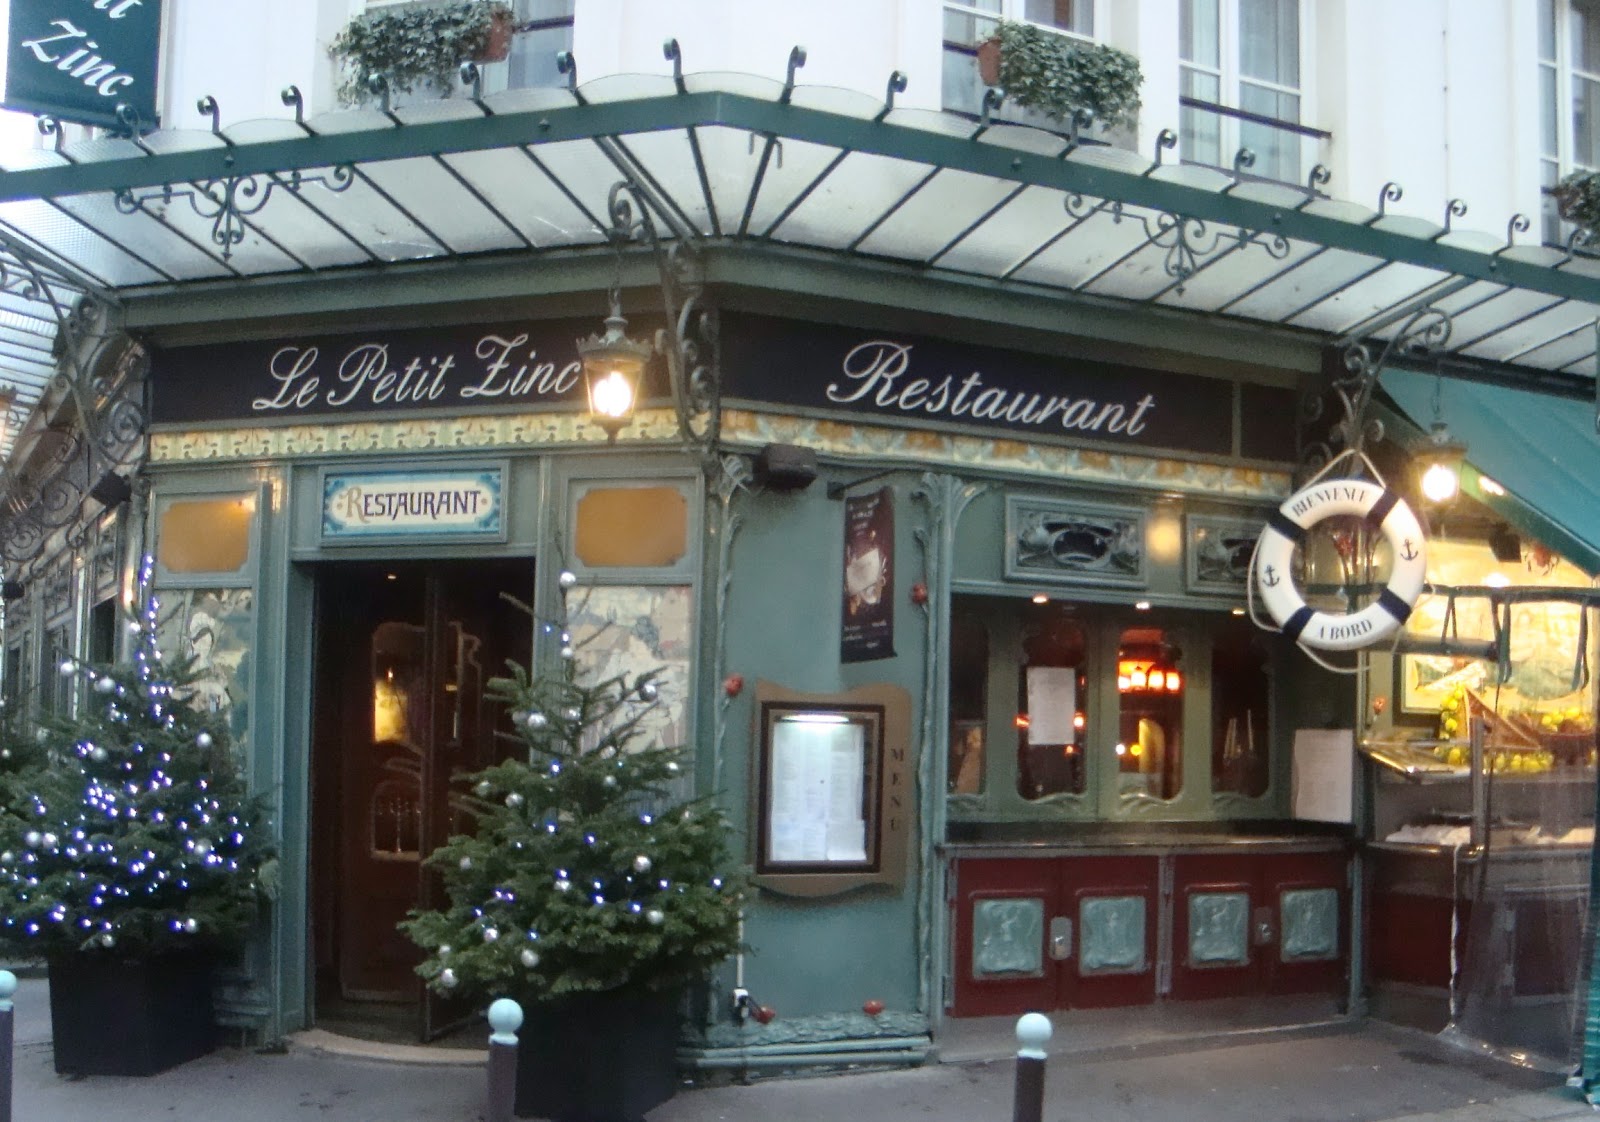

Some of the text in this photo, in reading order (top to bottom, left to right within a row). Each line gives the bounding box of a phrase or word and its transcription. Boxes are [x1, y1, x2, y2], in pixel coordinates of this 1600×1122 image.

[21, 20, 135, 97] Zinc
[252, 333, 582, 410] Le Petit Zinc
[826, 340, 1156, 436] Restaurant
[345, 486, 481, 521] RESTAURANT
